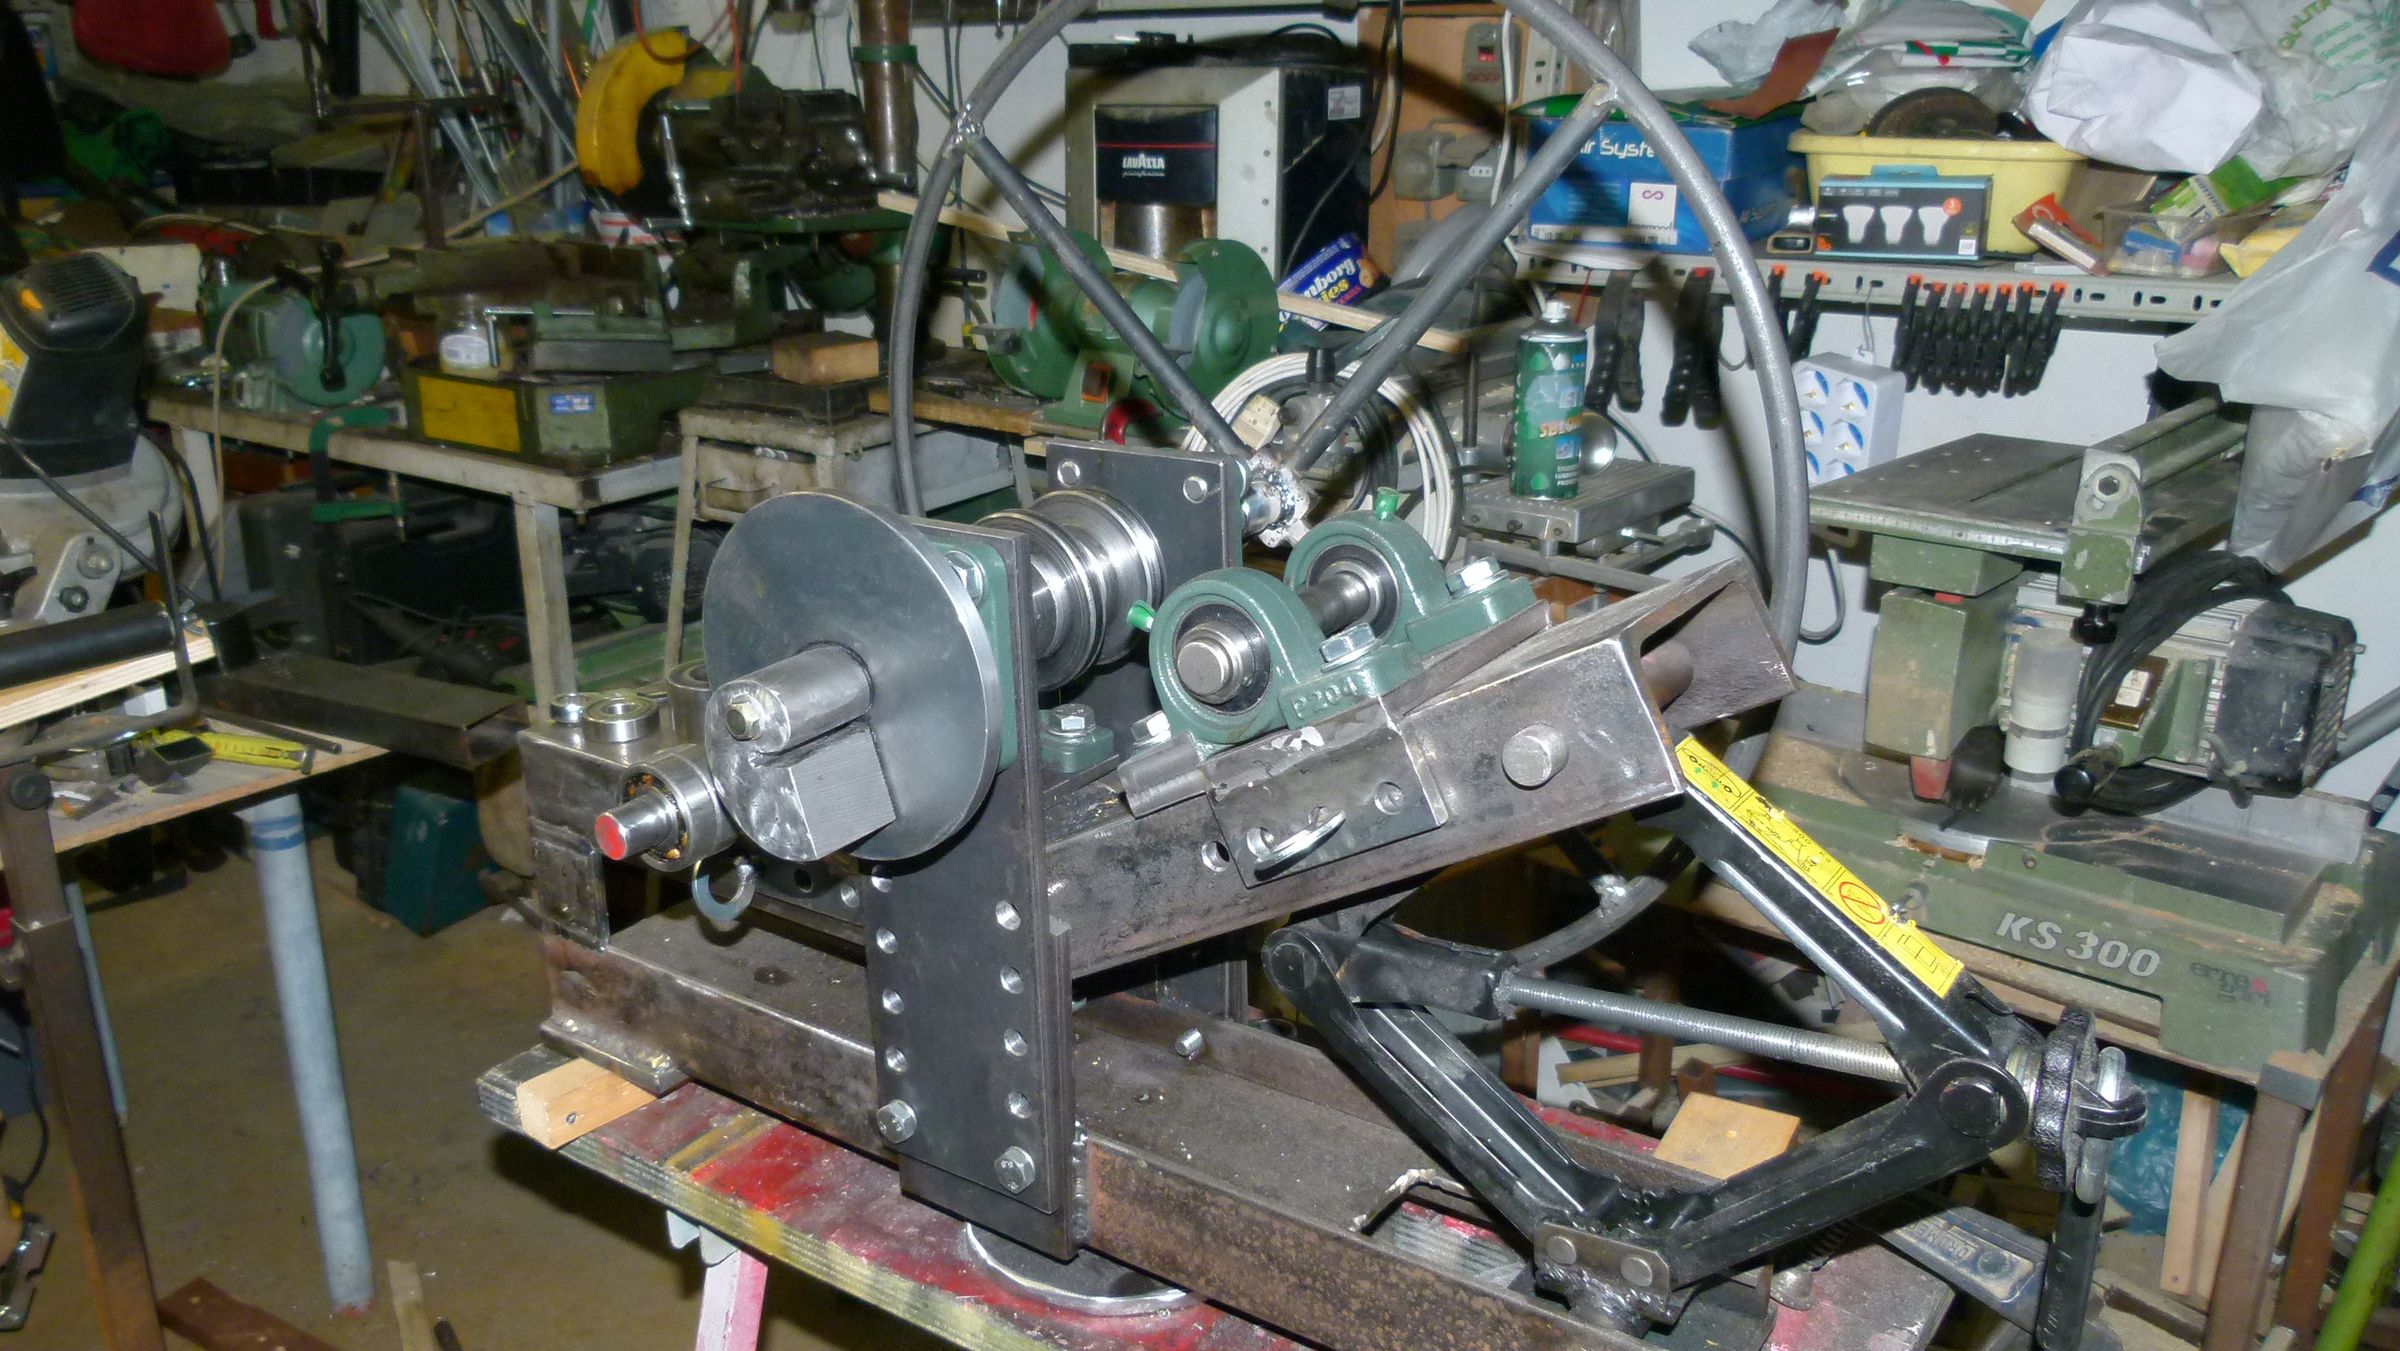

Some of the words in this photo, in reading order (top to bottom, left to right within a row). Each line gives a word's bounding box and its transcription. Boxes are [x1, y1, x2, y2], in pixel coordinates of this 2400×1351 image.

[1600, 139, 1655, 160] Syste
[1122, 153, 1165, 169] LAVAZZA
[1320, 279, 1350, 303] ies
[1996, 912, 2063, 950] KS
[2066, 930, 2161, 977] 300
